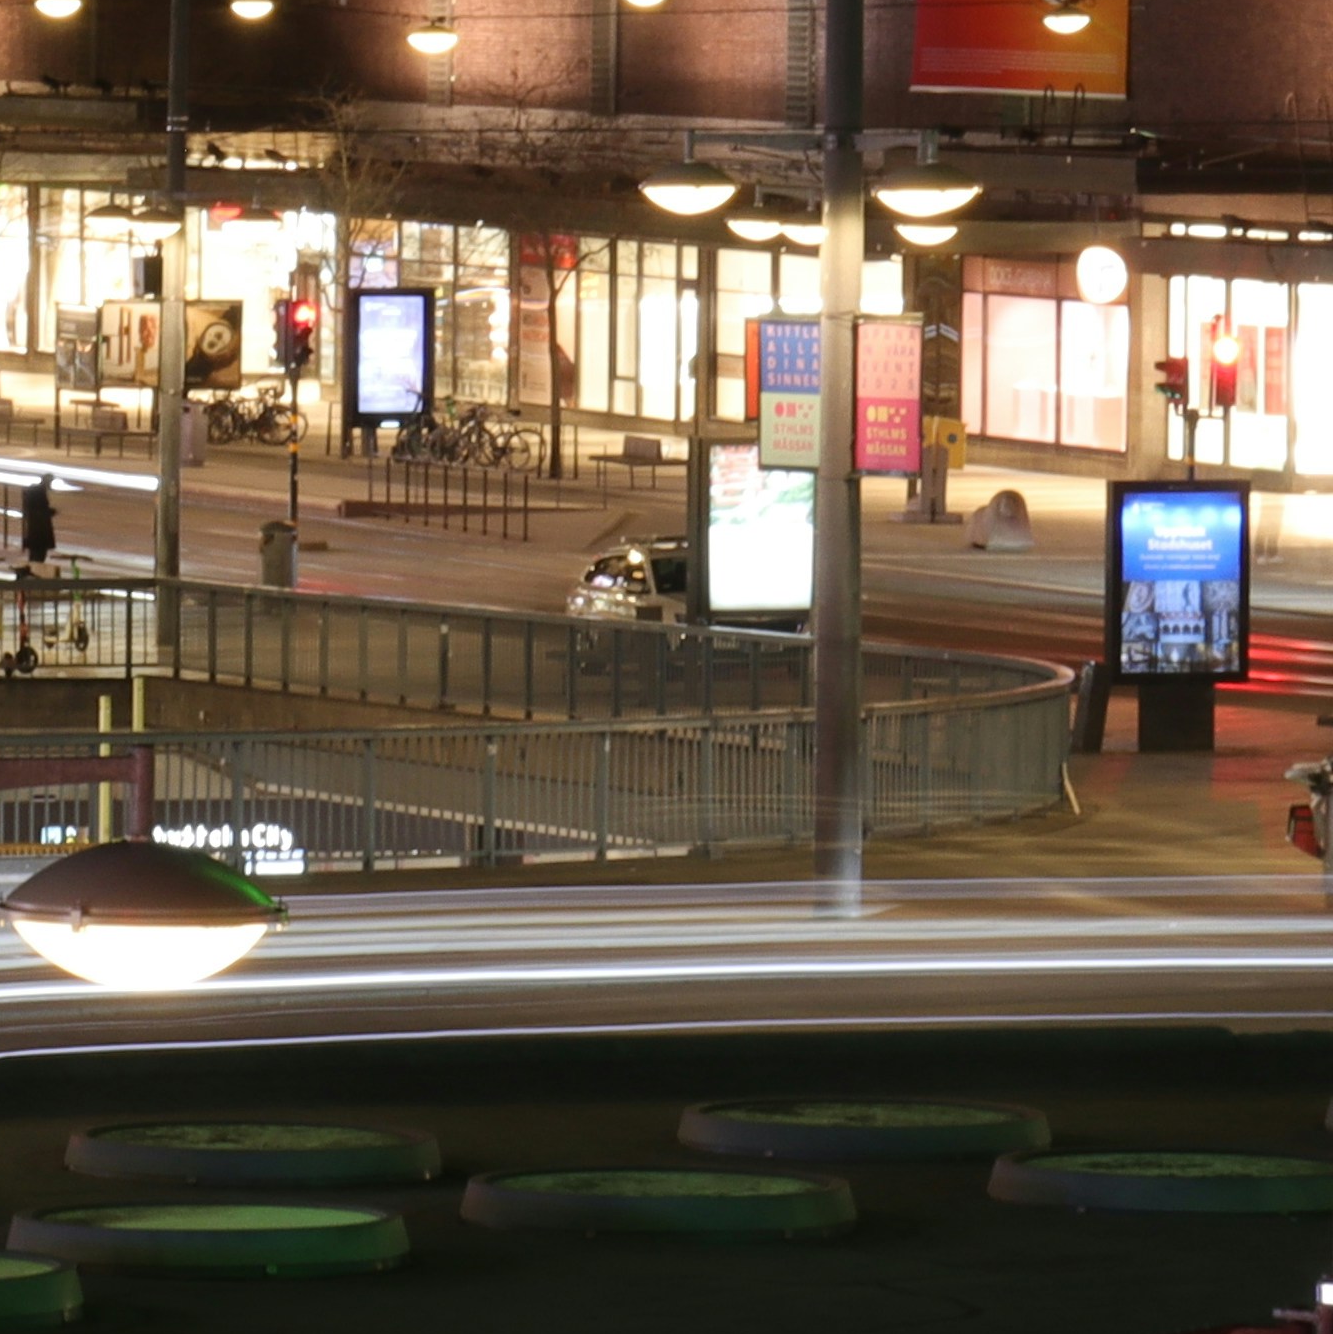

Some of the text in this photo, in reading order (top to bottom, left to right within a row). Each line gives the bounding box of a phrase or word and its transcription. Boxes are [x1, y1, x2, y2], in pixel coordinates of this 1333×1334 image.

[766, 324, 820, 339] KITTLA
[767, 340, 820, 354] ALLA
[767, 356, 820, 371] DINA
[767, 372, 820, 387] SINNEN
